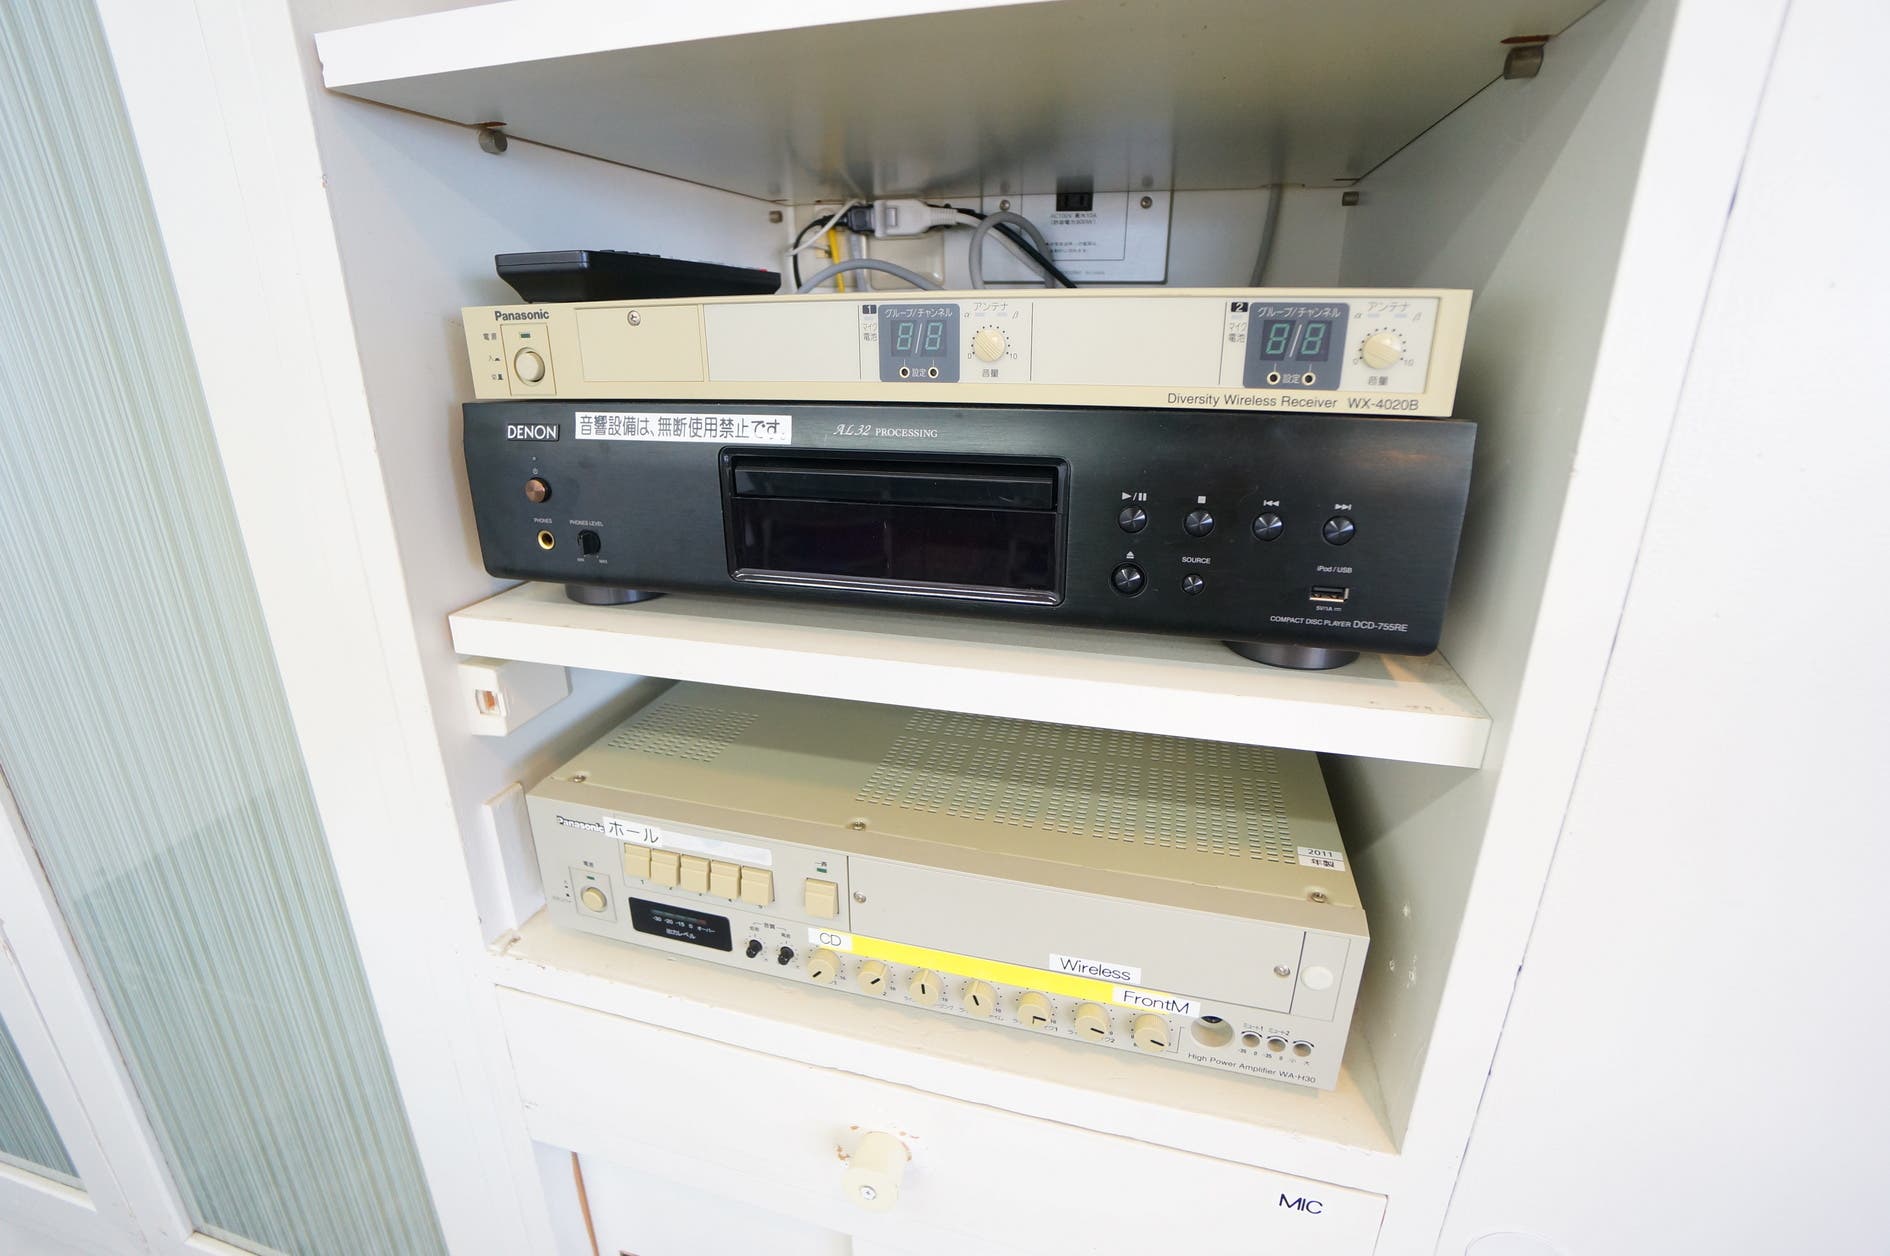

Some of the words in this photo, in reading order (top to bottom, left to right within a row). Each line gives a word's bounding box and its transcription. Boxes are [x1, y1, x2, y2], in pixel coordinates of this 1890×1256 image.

[973, 303, 1009, 312] アンテナ
[1257, 306, 1341, 319] グループ/チャンネル
[1367, 302, 1412, 312] アンテナ
[494, 309, 550, 321] Panasonic
[1167, 392, 1219, 407] Diversity
[1224, 393, 1277, 407] Wireless
[1281, 395, 1338, 409] Receiver
[1348, 397, 1419, 411] WX-4020B
[507, 425, 557, 440] DENON
[875, 427, 938, 438] PROCESSING
[1182, 556, 1211, 564] SOURCE
[1269, 615, 1304, 624] COMPACT
[1323, 619, 1352, 628] PLAYER
[1353, 620, 1409, 632] DCD-755RE
[609, 820, 659, 843] ホール
[1307, 848, 1333, 858] 2011
[819, 932, 842, 947] CD
[1059, 957, 1131, 982] Wireless
[1123, 990, 1190, 1015] FrontM
[1187, 1051, 1208, 1063] High
[1210, 1056, 1237, 1068] Power
[1238, 1062, 1277, 1076] Amplifier
[1279, 1193, 1323, 1215] MIC
